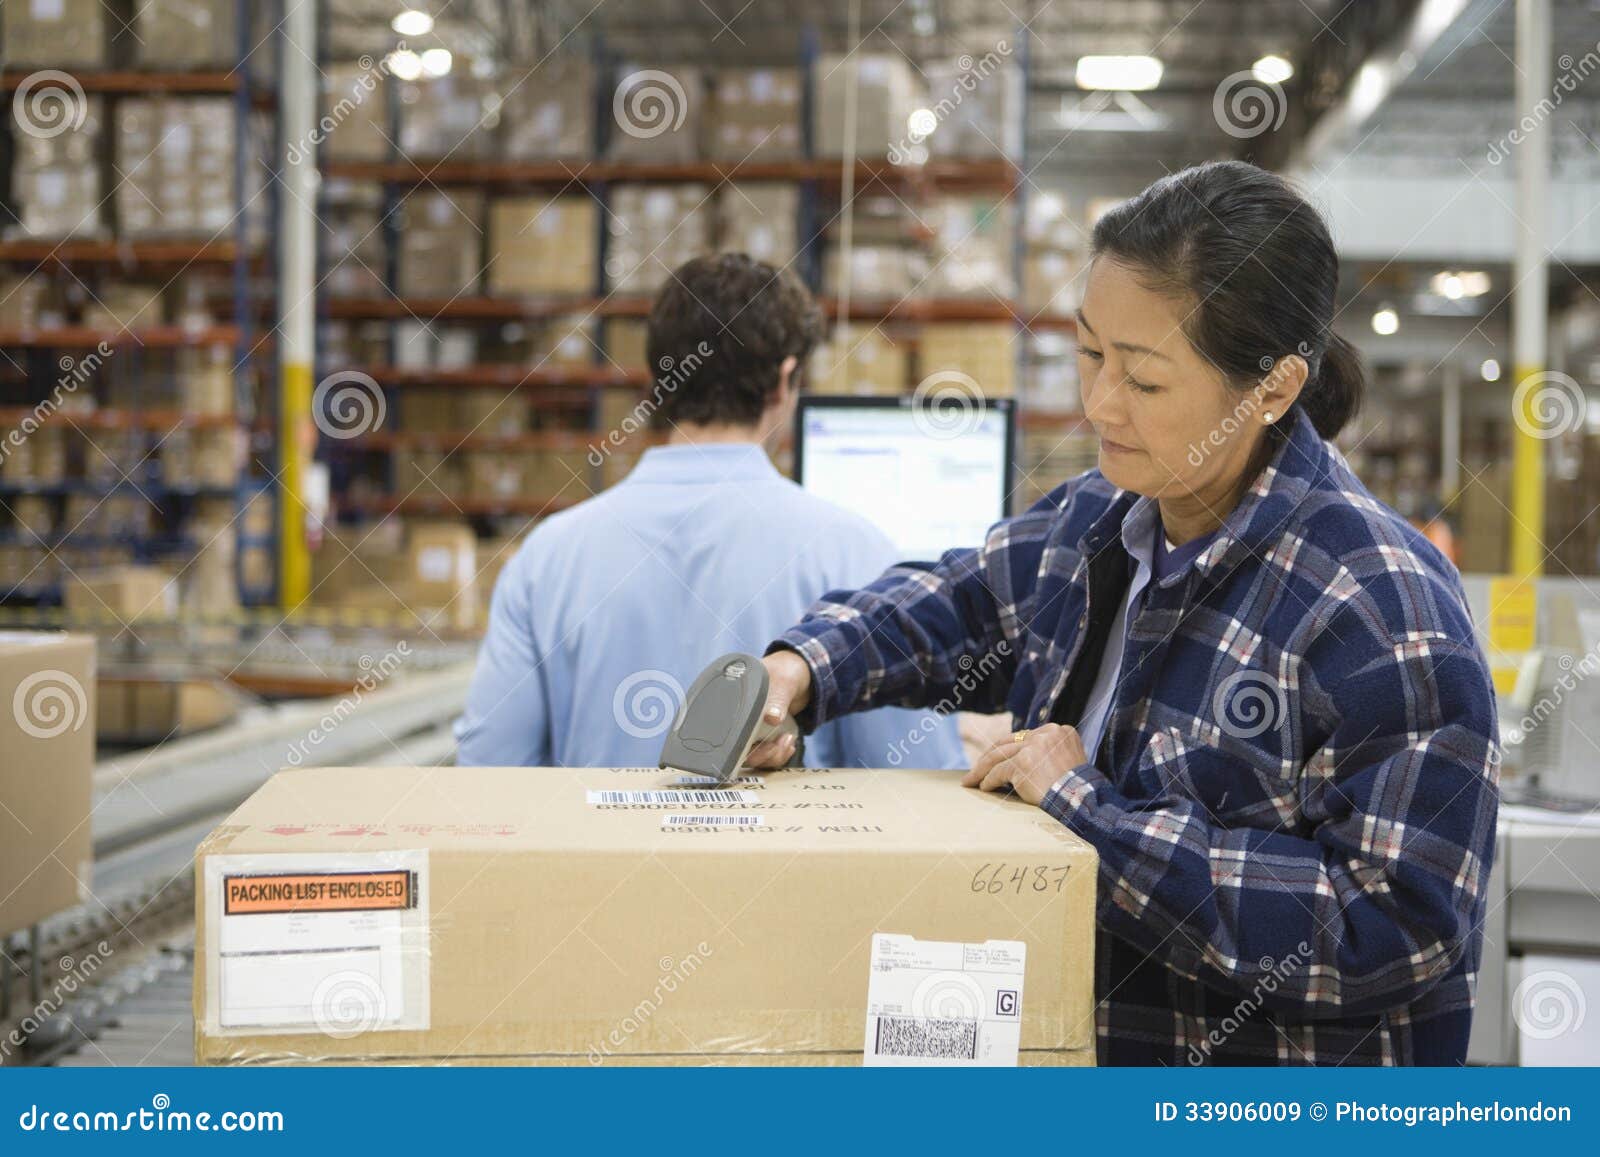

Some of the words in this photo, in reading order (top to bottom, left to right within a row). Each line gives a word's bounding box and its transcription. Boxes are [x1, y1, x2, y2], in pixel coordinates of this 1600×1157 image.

[818, 825, 883, 833] ITEM
[971, 863, 1072, 894] 66487
[231, 882, 293, 902] PACKING
[296, 881, 326, 900] LIST
[328, 880, 404, 899] ENCLOSED
[1000, 993, 1013, 1013] G
